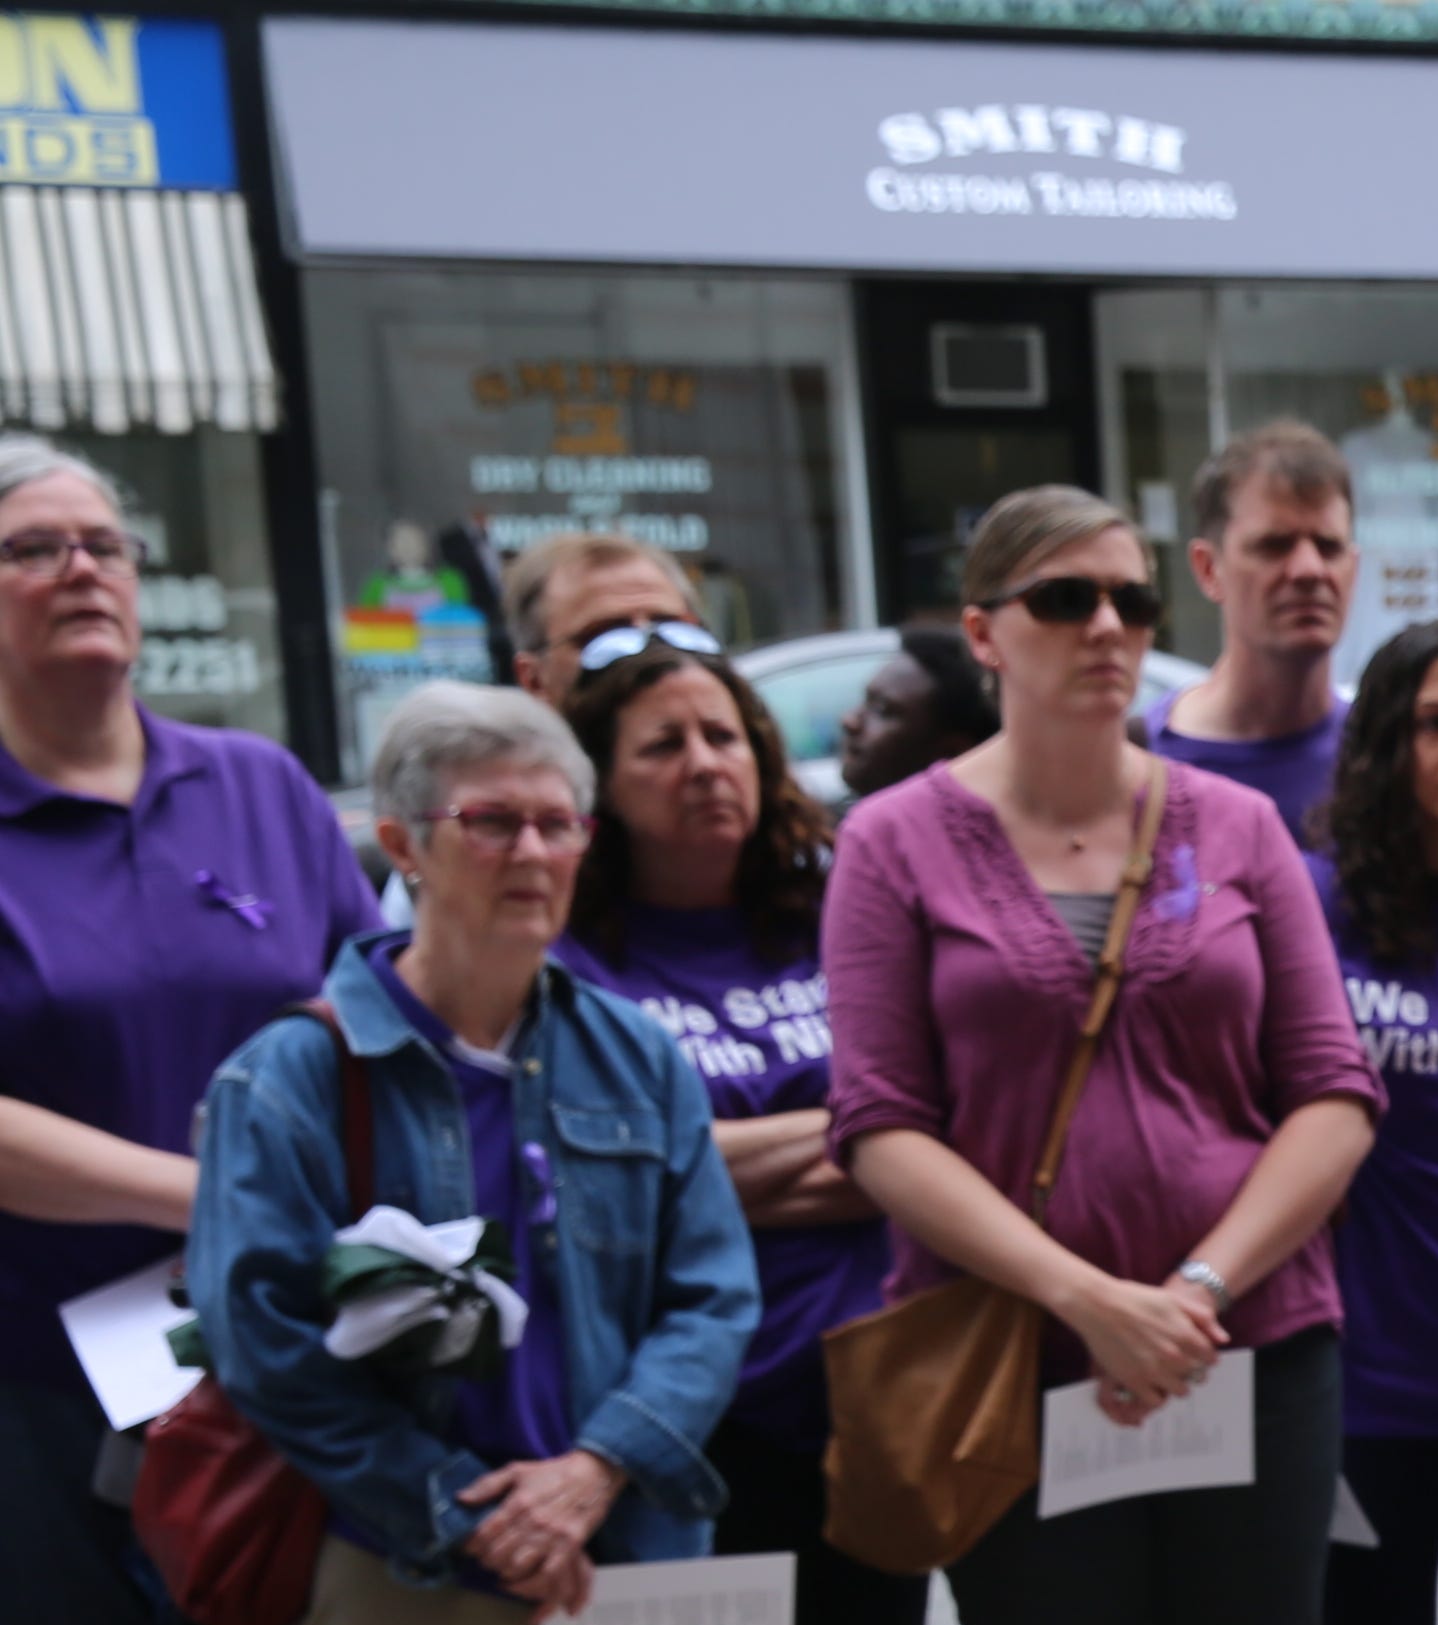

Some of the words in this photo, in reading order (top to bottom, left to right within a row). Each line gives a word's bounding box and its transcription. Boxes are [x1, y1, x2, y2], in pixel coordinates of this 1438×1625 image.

[0, 120, 138, 180] DS
[878, 103, 1188, 174] SMITH
[865, 166, 1033, 215] CUSTOM
[1030, 171, 1238, 221] TAILORING
[544, 455, 713, 494] CLEANING
[1346, 977, 1429, 1025] We
